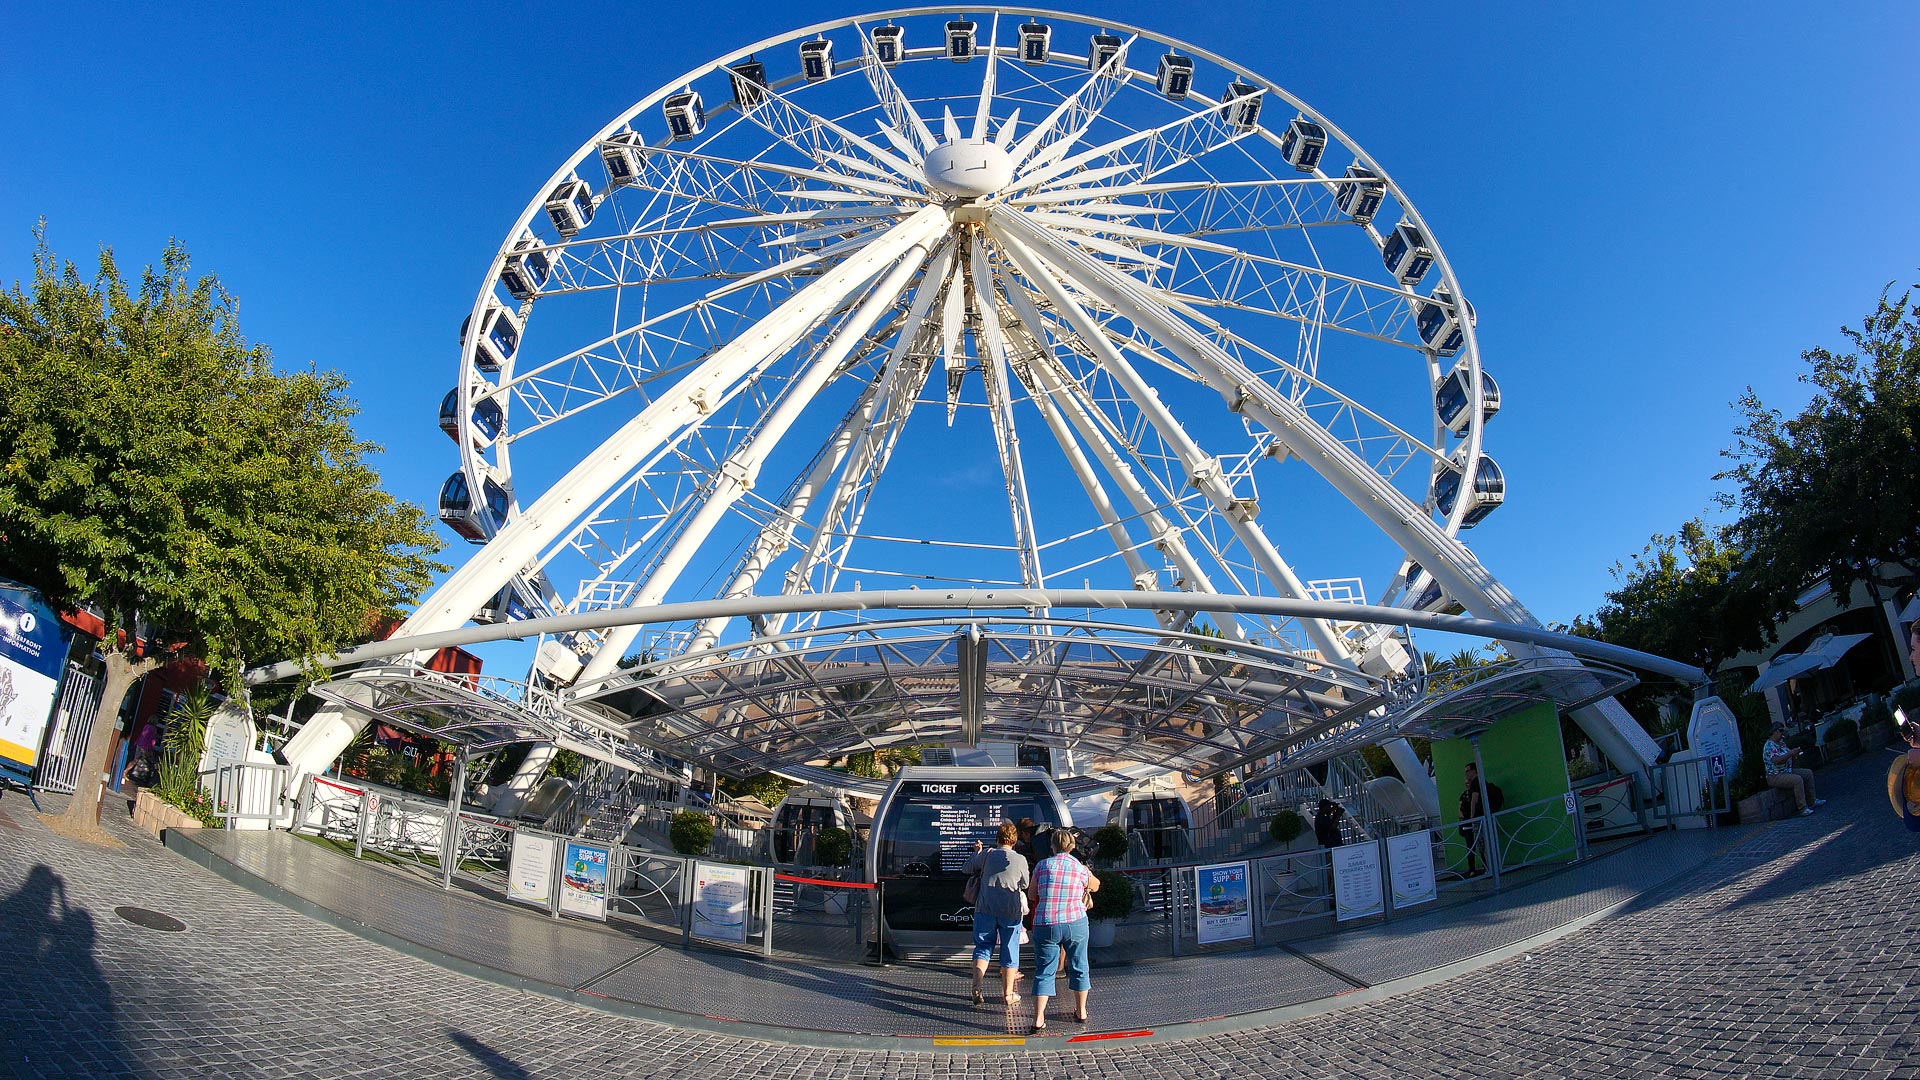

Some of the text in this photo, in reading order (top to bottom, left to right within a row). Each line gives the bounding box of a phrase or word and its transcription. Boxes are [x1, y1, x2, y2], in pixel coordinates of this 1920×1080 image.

[2, 636, 41, 658] INFORMATION
[5, 629, 43, 651] WATERFRONT
[921, 784, 1020, 794] TICKET OFFICE
[939, 913, 970, 922] Cape
